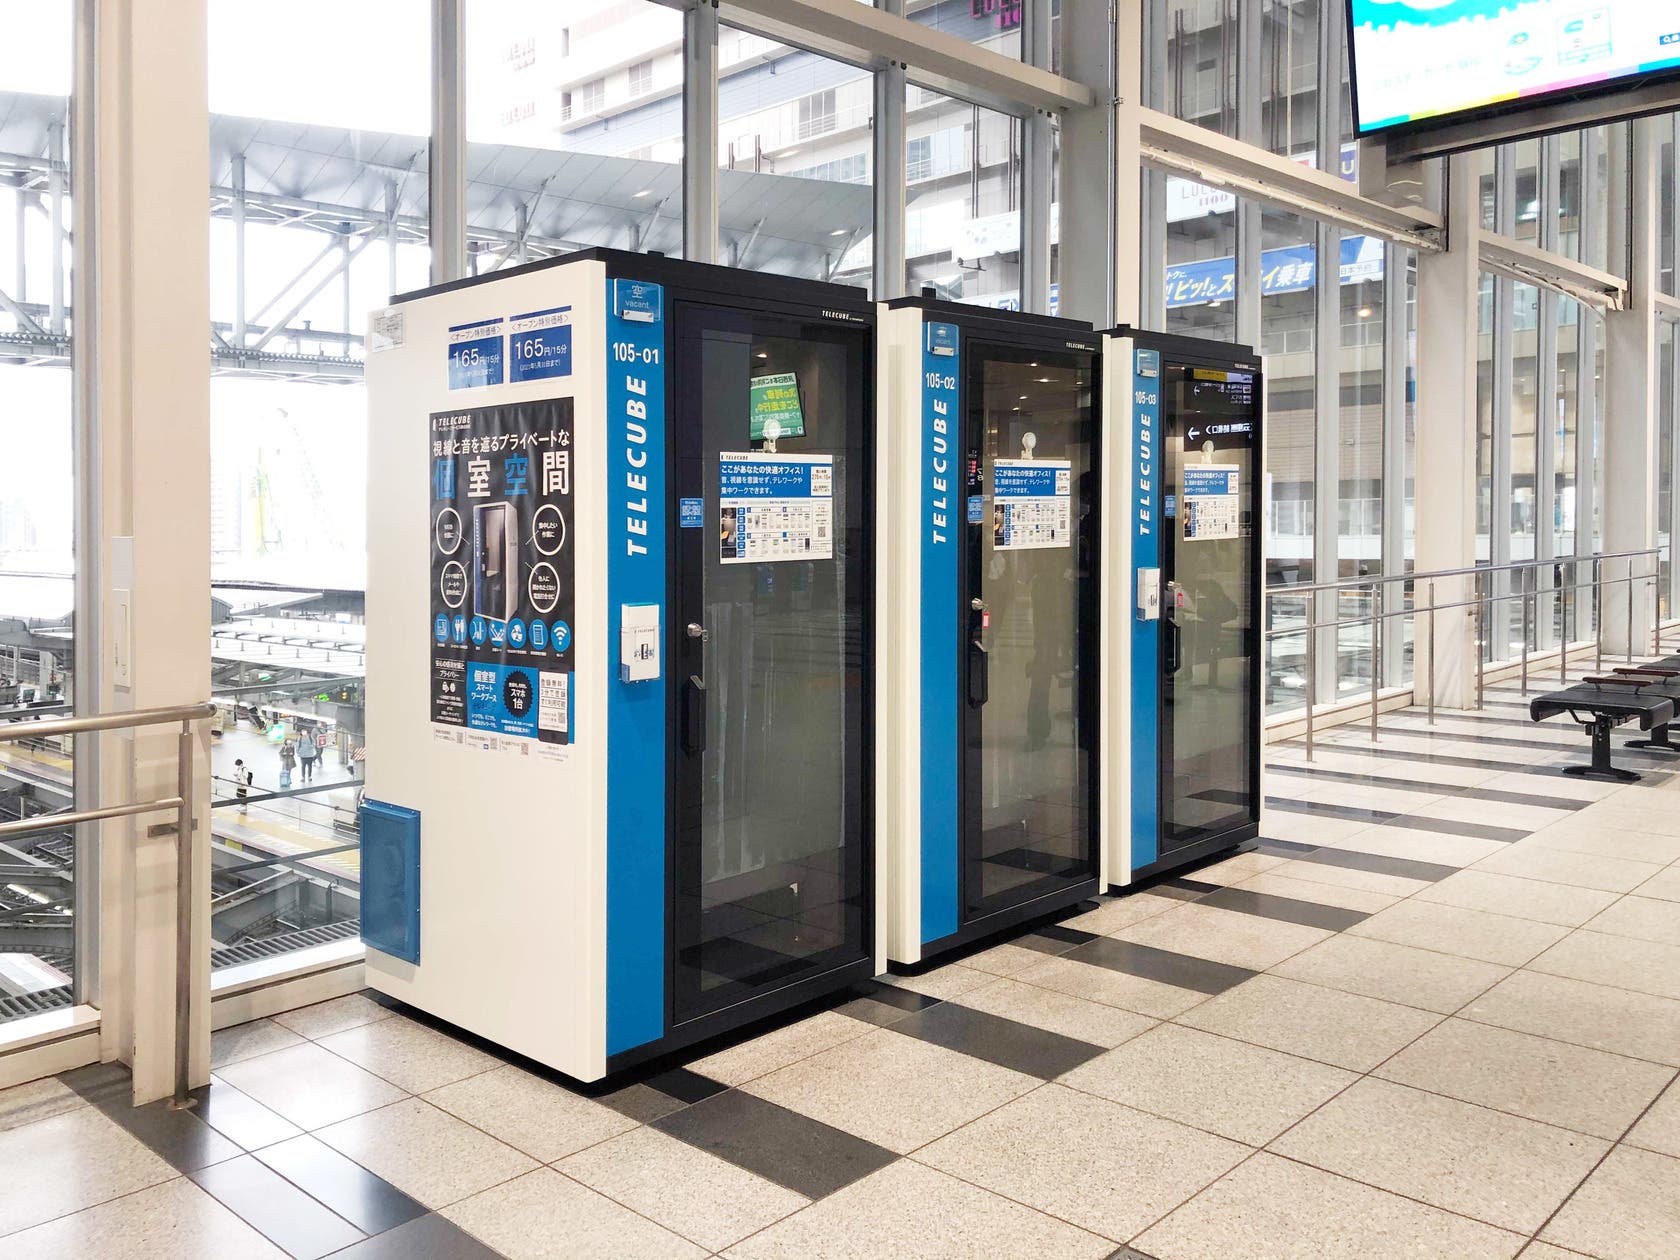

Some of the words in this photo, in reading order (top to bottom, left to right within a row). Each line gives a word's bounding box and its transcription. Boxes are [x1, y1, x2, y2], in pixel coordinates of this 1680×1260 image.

[625, 300, 649, 309] vacant
[822, 310, 849, 320] TELECUBE
[613, 342, 659, 364] 105-01
[926, 372, 955, 390] 105-02
[1135, 391, 1157, 405] 105-03
[438, 414, 472, 426] TELECUBE
[433, 429, 570, 457] 視線と音を遮るプライベートな
[627, 375, 647, 557] TELECUBE
[933, 399, 947, 545] TELECUBE
[1140, 413, 1151, 536] TELECUBE
[434, 450, 570, 501] 個室空間
[510, 688, 526, 698] スマホ
[512, 697, 524, 710] 1台
